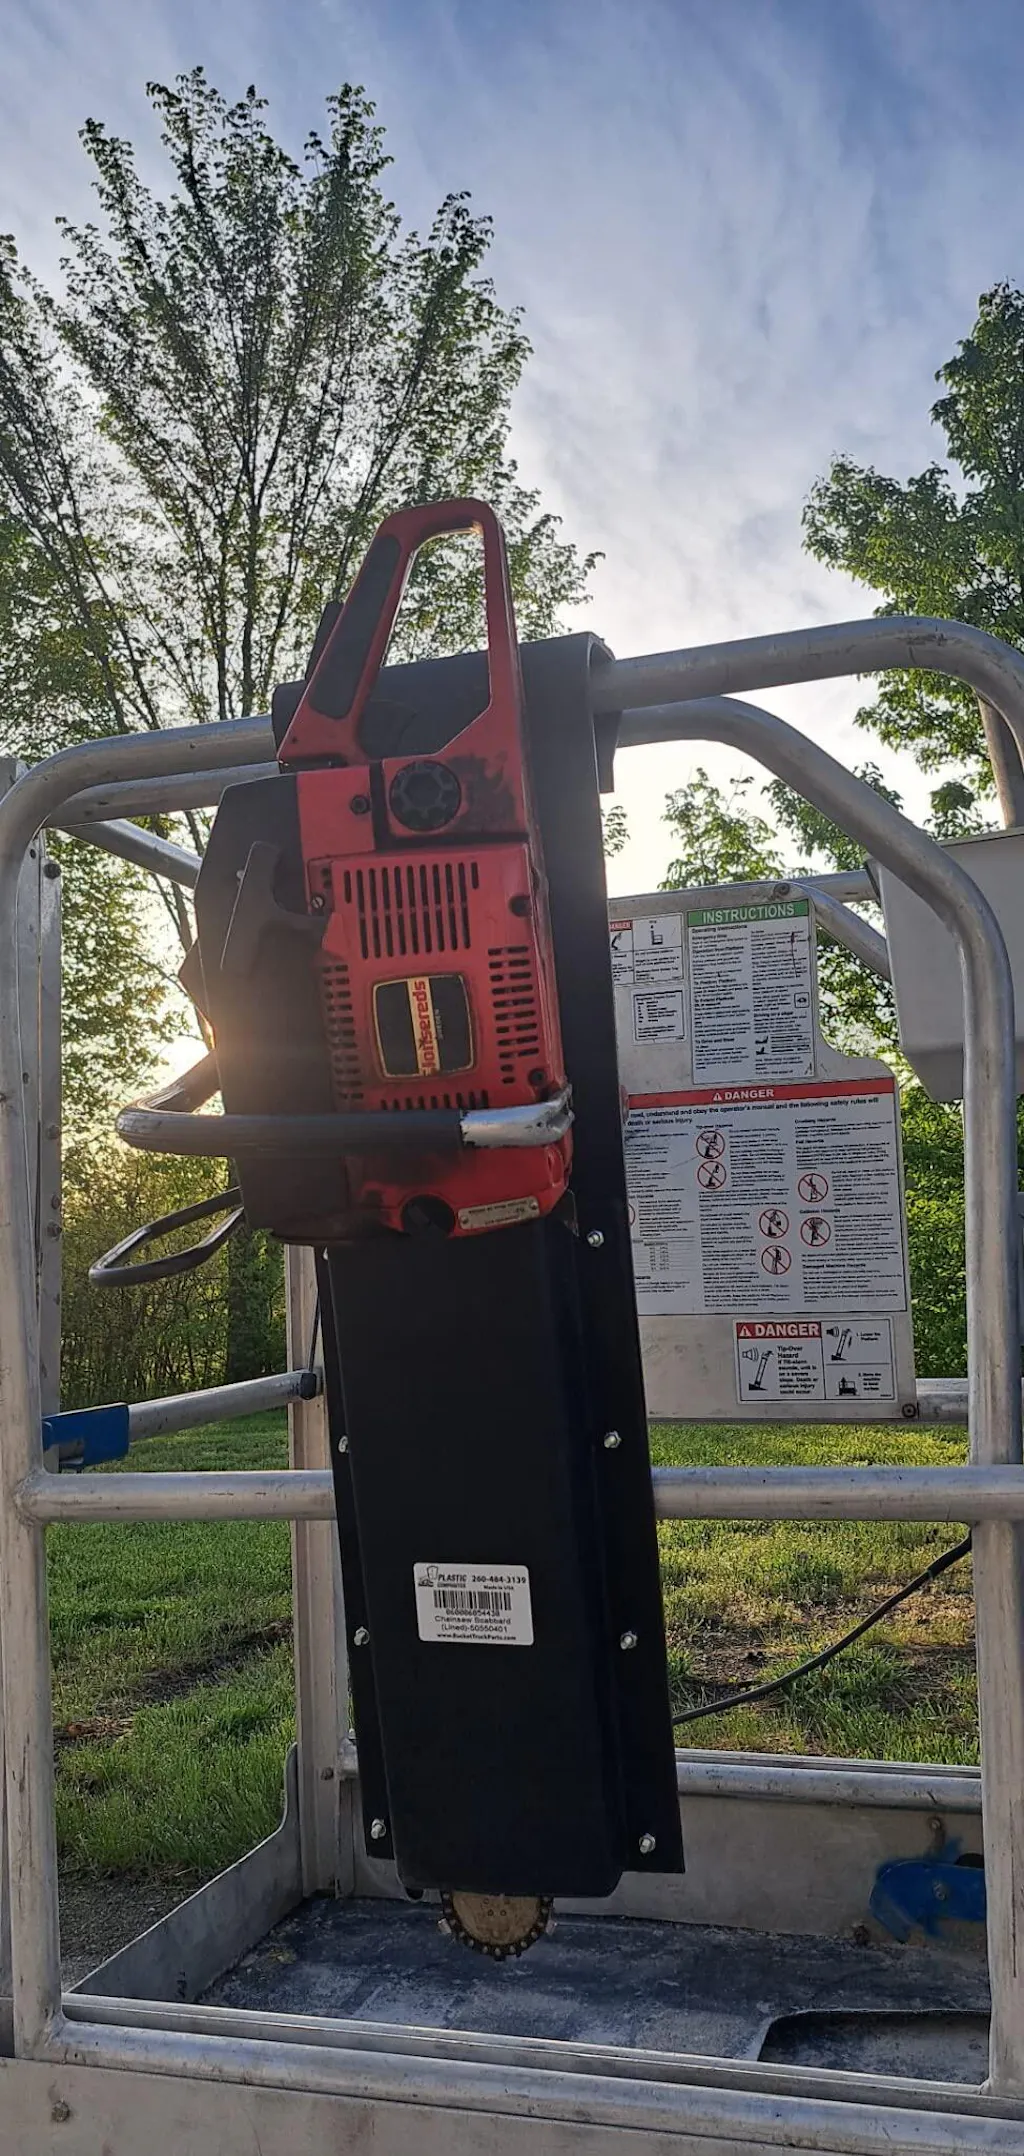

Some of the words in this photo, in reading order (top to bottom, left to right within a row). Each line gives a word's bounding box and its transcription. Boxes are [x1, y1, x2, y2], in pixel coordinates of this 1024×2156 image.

[702, 903, 795, 924] INSTRUCTIONS
[724, 1088, 774, 1100] DANGER
[693, 1108, 707, 1116] obey
[720, 1105, 750, 1113] operator's
[752, 1102, 774, 1110] manual
[789, 1101, 799, 1109] the
[830, 1099, 848, 1107] safety
[755, 1323, 819, 1337] DANGER
[438, 1574, 467, 1582] PLASTIC
[471, 1575, 526, 1584] 260-484-3139
[434, 1615, 472, 1623] Chainsaw
[474, 1616, 511, 1625] Scabbard
[441, 1623, 508, 1633] (Lined)-50550401
[437, 1632, 516, 1641] www.BucketTruckParts.com
